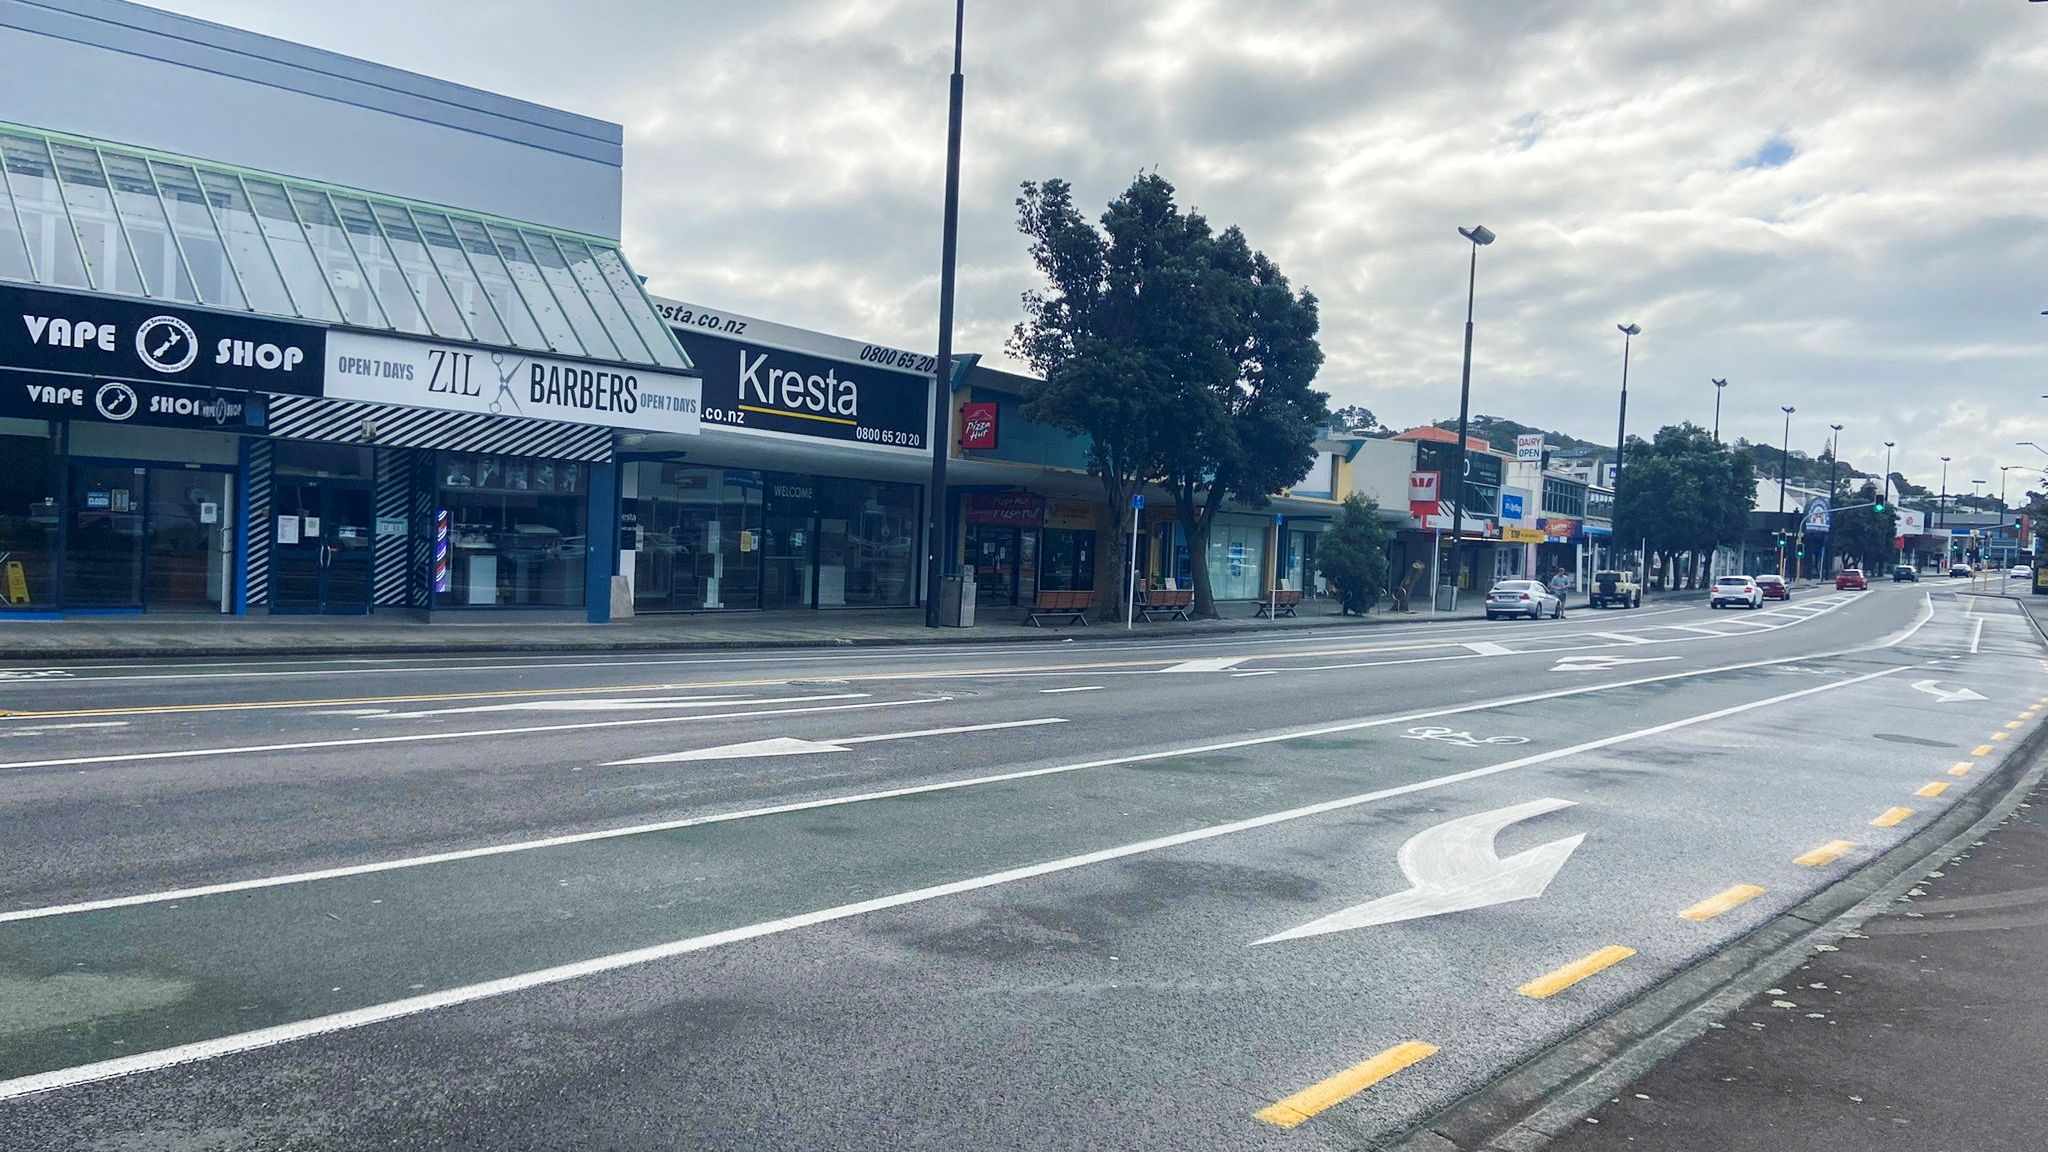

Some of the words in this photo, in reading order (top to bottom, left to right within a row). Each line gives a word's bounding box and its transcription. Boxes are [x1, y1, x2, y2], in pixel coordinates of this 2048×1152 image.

[23, 314, 116, 352] VAPE
[215, 338, 304, 372] SHOP
[860, 345, 898, 365] 0800
[897, 354, 917, 369] 65
[915, 356, 935, 373] 20
[338, 356, 372, 377] OPEN
[374, 359, 381, 378] 7
[383, 361, 414, 381] DAYS
[428, 350, 481, 397] ZIL
[530, 363, 638, 414] BARBERS
[738, 350, 858, 416] Kresta
[26, 385, 83, 406] VAPE
[640, 393, 664, 409] OPEN
[665, 396, 672, 411] 7
[673, 397, 697, 414] DAYS
[856, 426, 881, 442] 0800
[882, 430, 894, 443] 65
[895, 432, 907, 445] 20
[908, 433, 920, 446] 20
[966, 420, 991, 434] Pizza
[970, 429, 988, 442] Hut
[1518, 448, 1540, 457] OPEN
[1519, 437, 1541, 447] DAIRY
[774, 484, 813, 499] WELCOME
